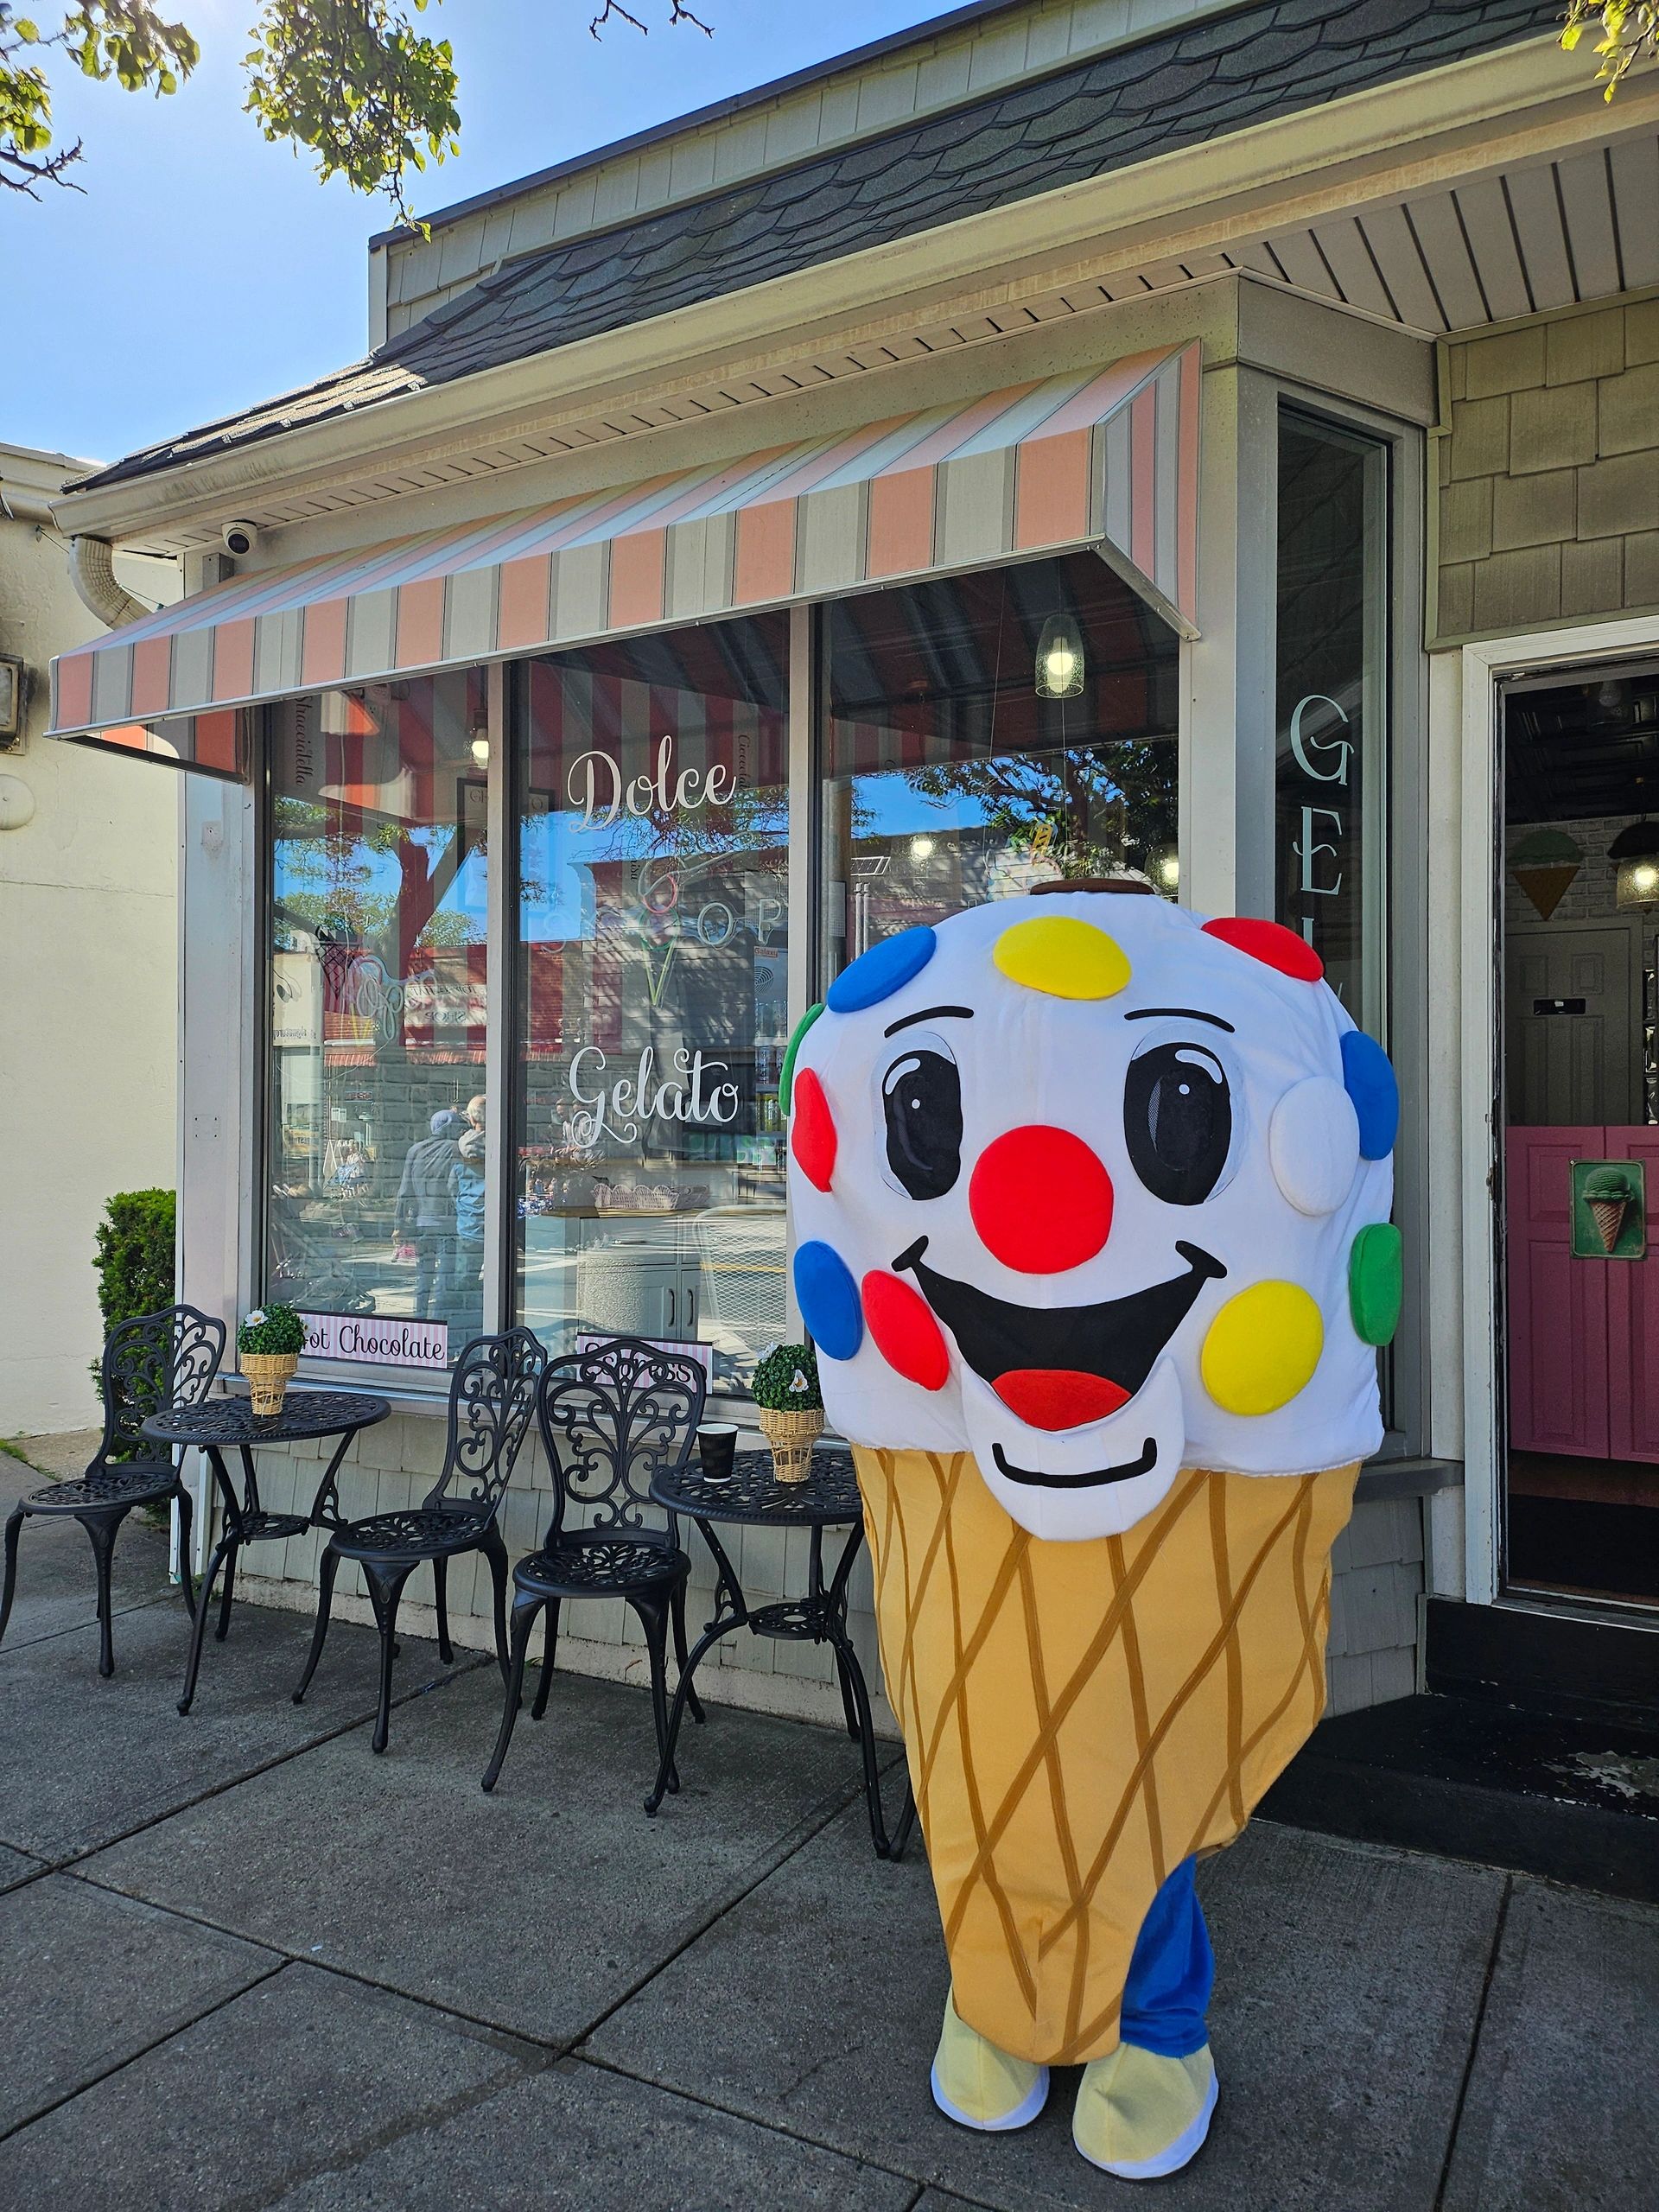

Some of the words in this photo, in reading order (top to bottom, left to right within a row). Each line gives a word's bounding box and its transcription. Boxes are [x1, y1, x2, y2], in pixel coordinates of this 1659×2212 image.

[567, 734, 737, 834] Dolce
[753, 947, 779, 958] Galaxy
[569, 1046, 739, 1148] Gelato
[339, 1324, 446, 1361] Chocolate
